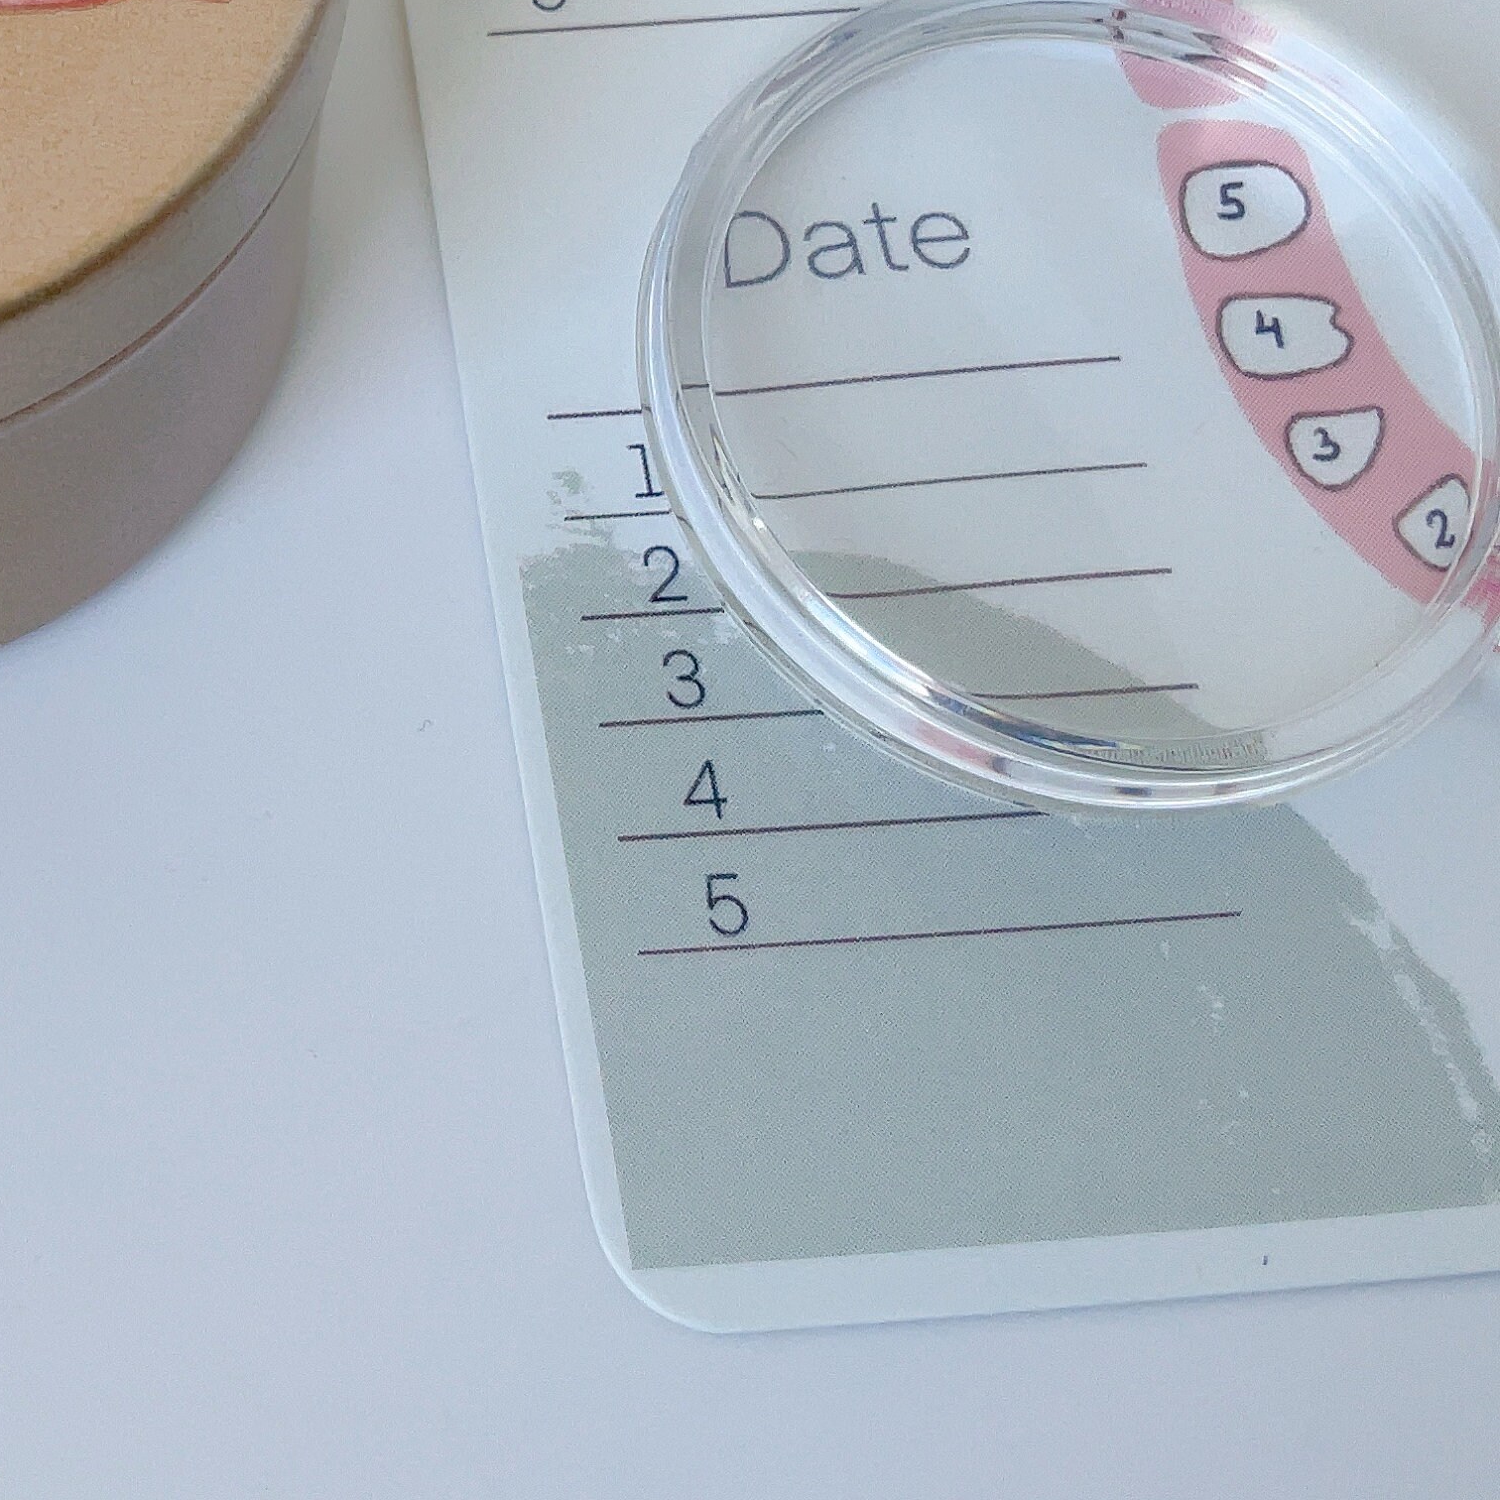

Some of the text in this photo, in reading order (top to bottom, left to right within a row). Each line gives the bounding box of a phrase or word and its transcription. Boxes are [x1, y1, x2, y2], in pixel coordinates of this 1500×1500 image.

[1217, 181, 1246, 221] 5
[723, 202, 970, 288] Date
[1255, 310, 1284, 349] 4
[627, 443, 664, 498] 1
[1312, 427, 1341, 462] 3
[1426, 509, 1456, 549] 2
[643, 545, 688, 603] 2
[663, 649, 706, 710] 3
[683, 759, 728, 820] 4
[705, 872, 749, 935] 5
